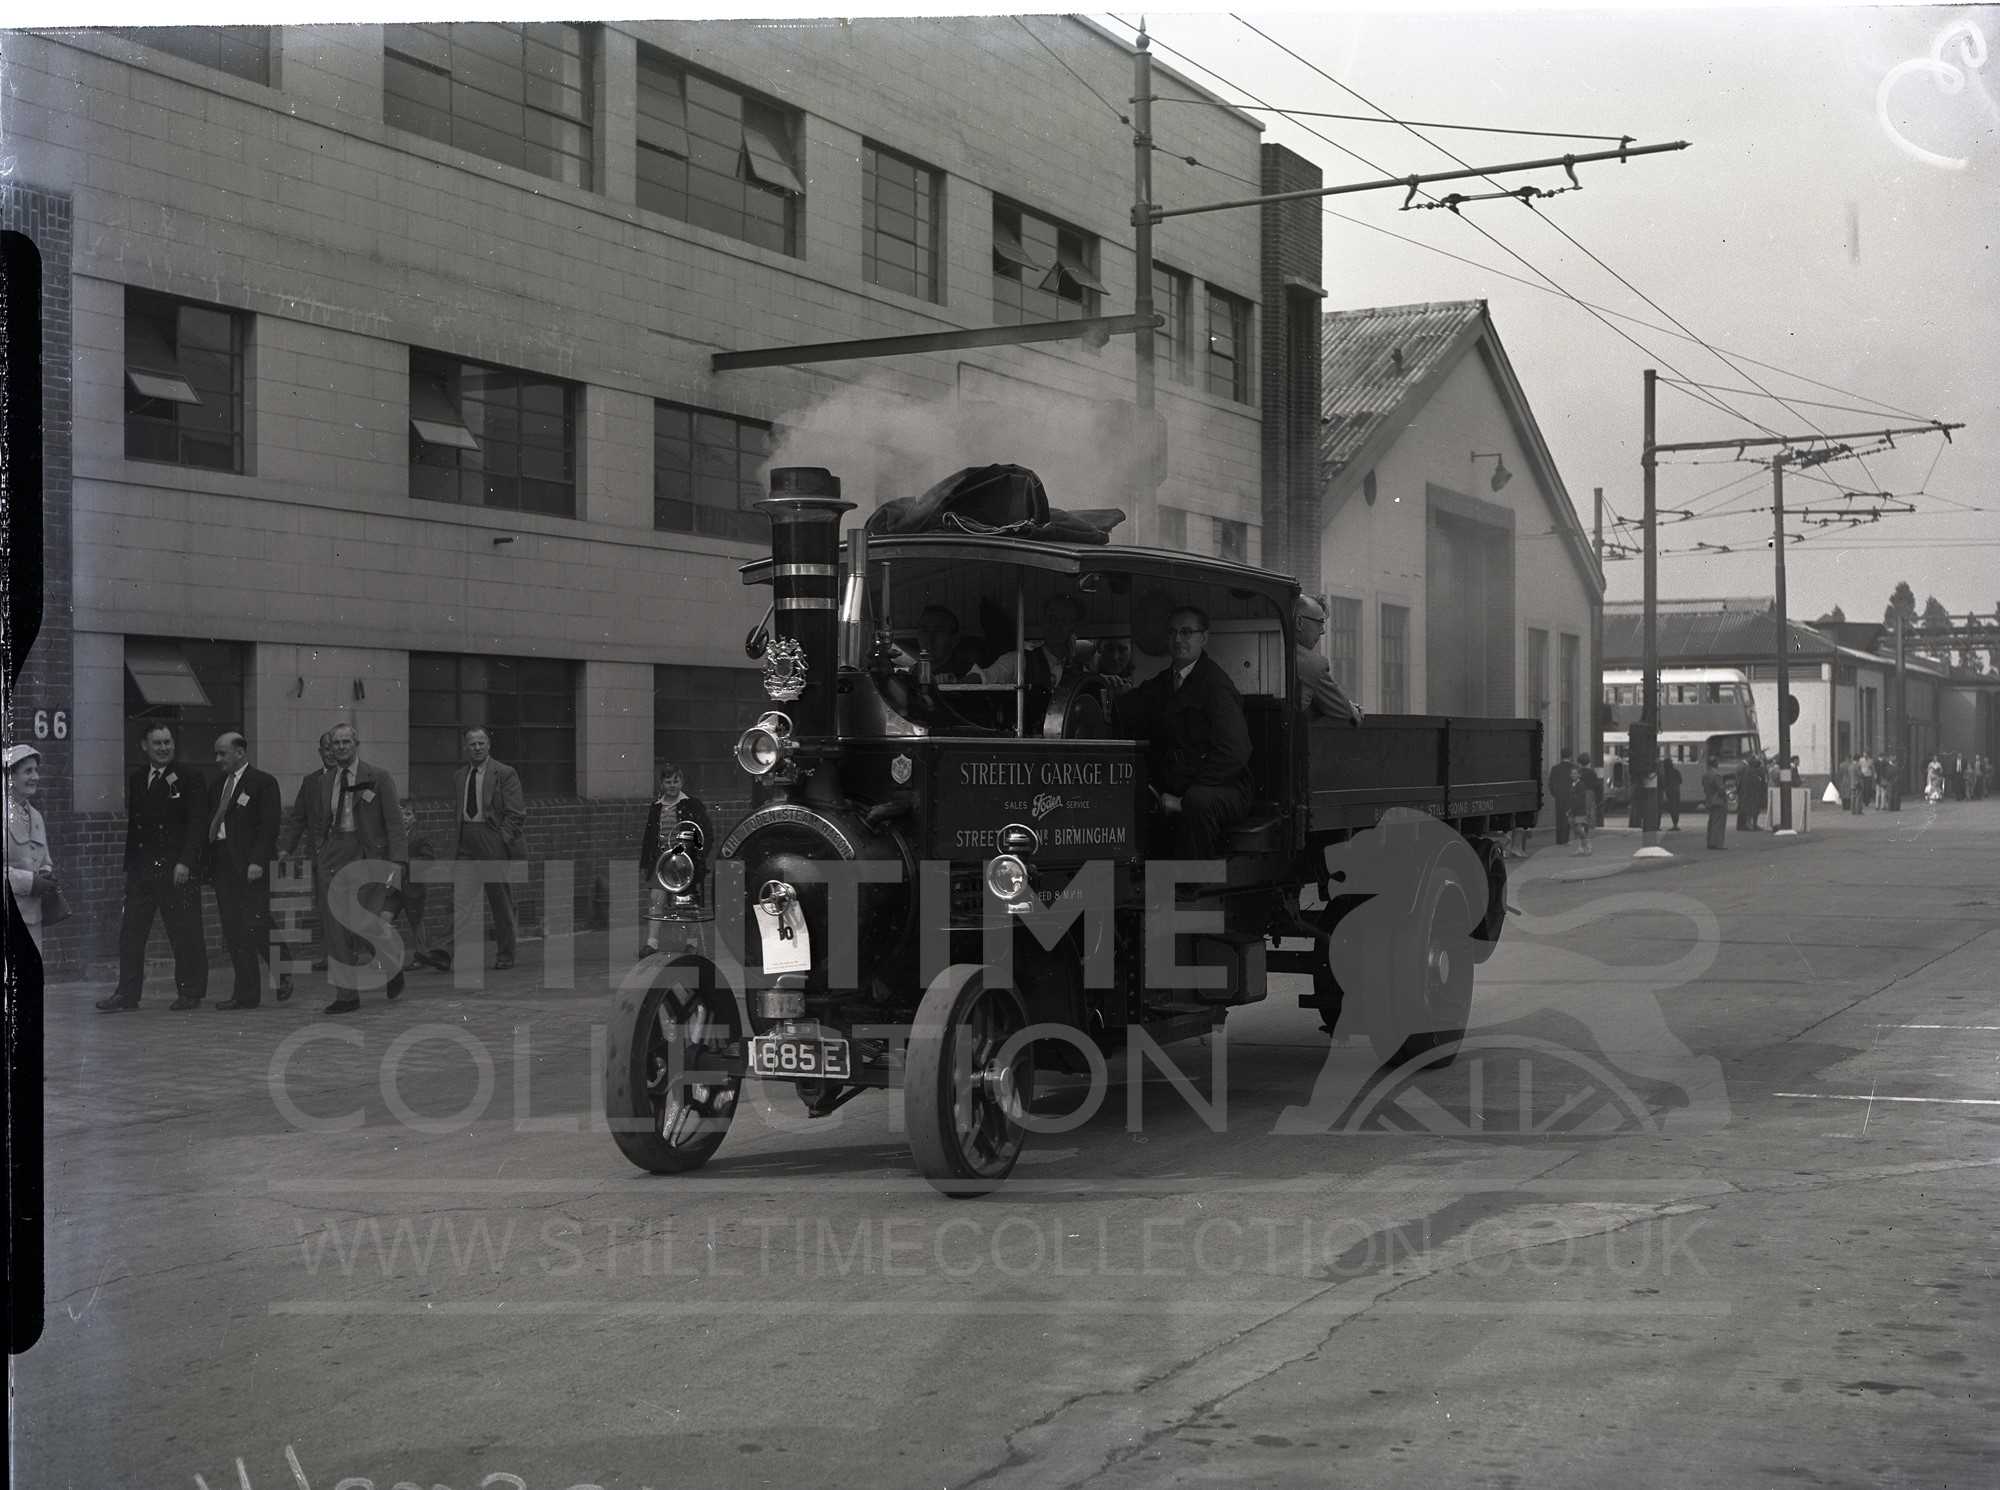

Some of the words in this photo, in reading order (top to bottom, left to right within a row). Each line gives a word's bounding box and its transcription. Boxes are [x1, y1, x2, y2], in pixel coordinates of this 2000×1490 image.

[33, 710, 68, 740] 66
[960, 762, 1034, 786] STREETLY
[1041, 762, 1103, 786] GARAGE
[1004, 801, 1028, 810] SALES
[1066, 801, 1090, 809] SERVICE
[956, 830, 1017, 847] STREETL
[1055, 827, 1126, 846] BIRMINGHAM
